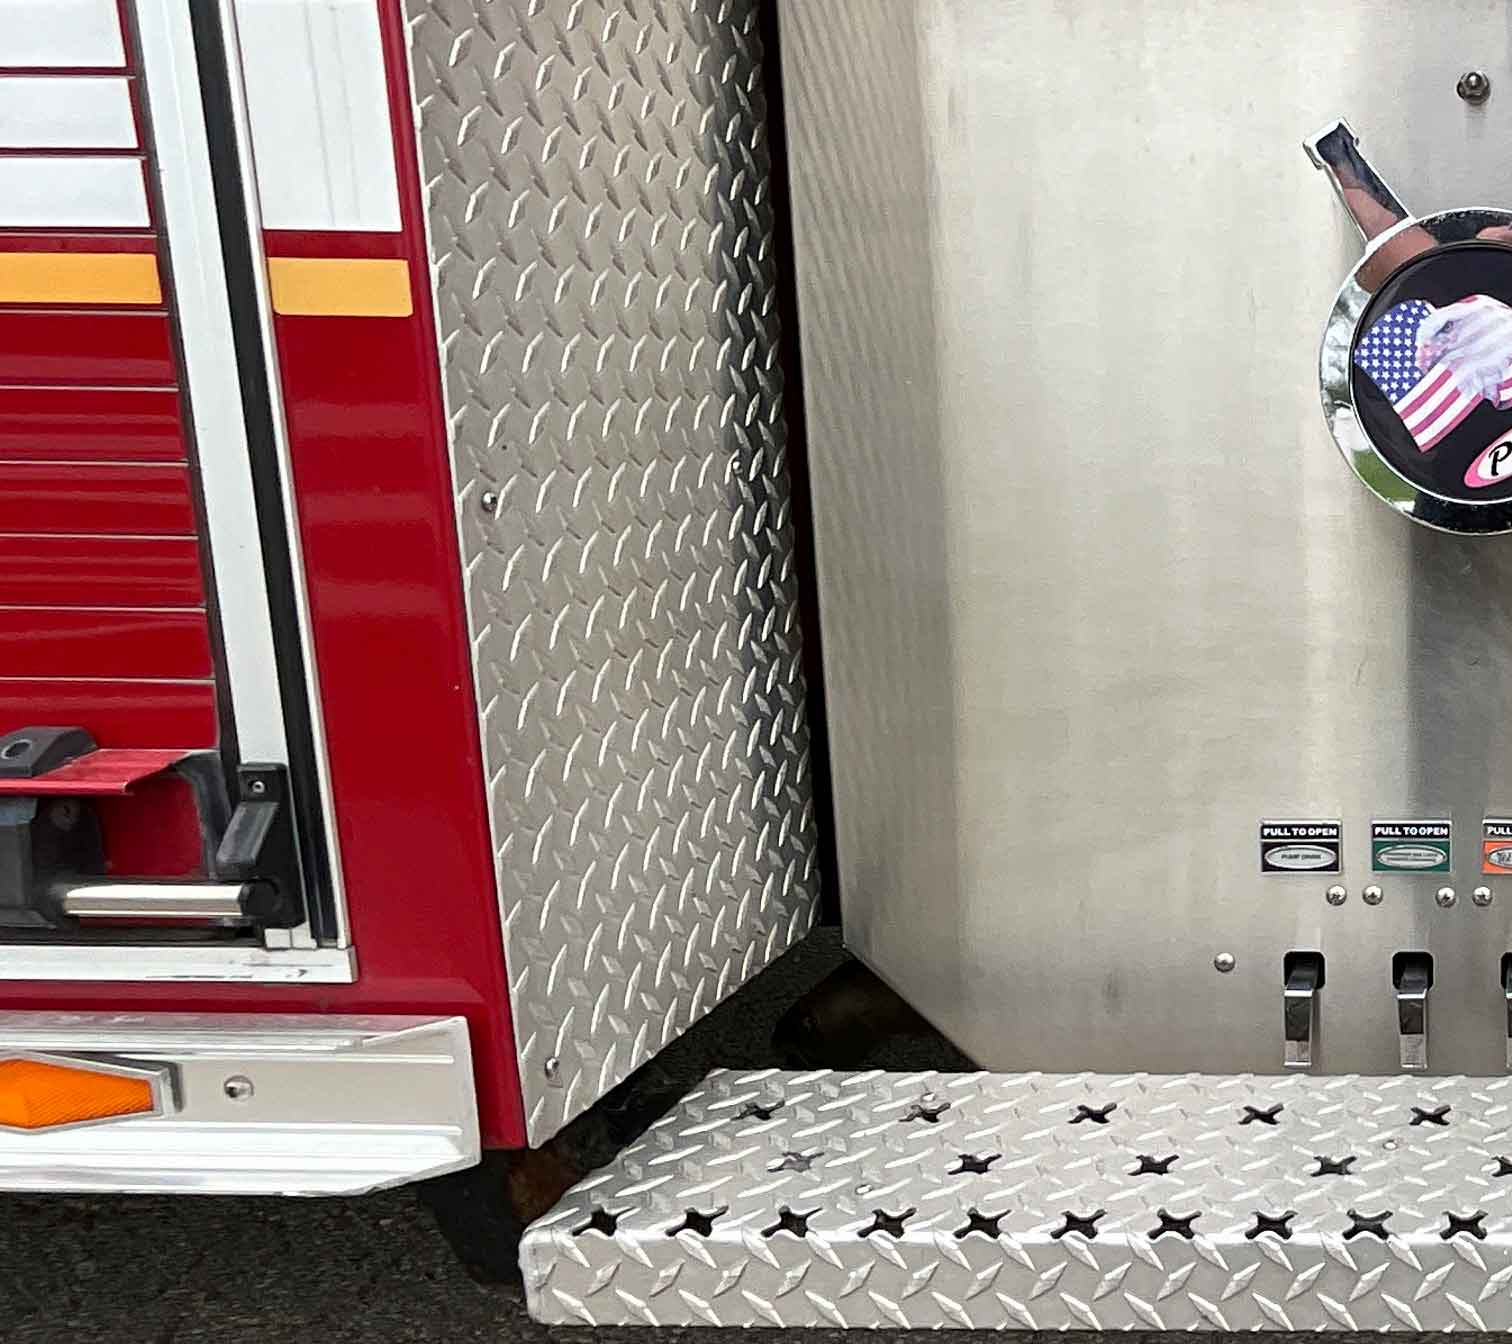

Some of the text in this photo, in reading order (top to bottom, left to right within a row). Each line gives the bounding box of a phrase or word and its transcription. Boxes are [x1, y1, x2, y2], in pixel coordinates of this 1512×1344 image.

[1263, 827, 1337, 836] PULL TO OPEN
[1375, 826, 1448, 836] PULL TO OPEN
[1487, 826, 1512, 835] PULL
